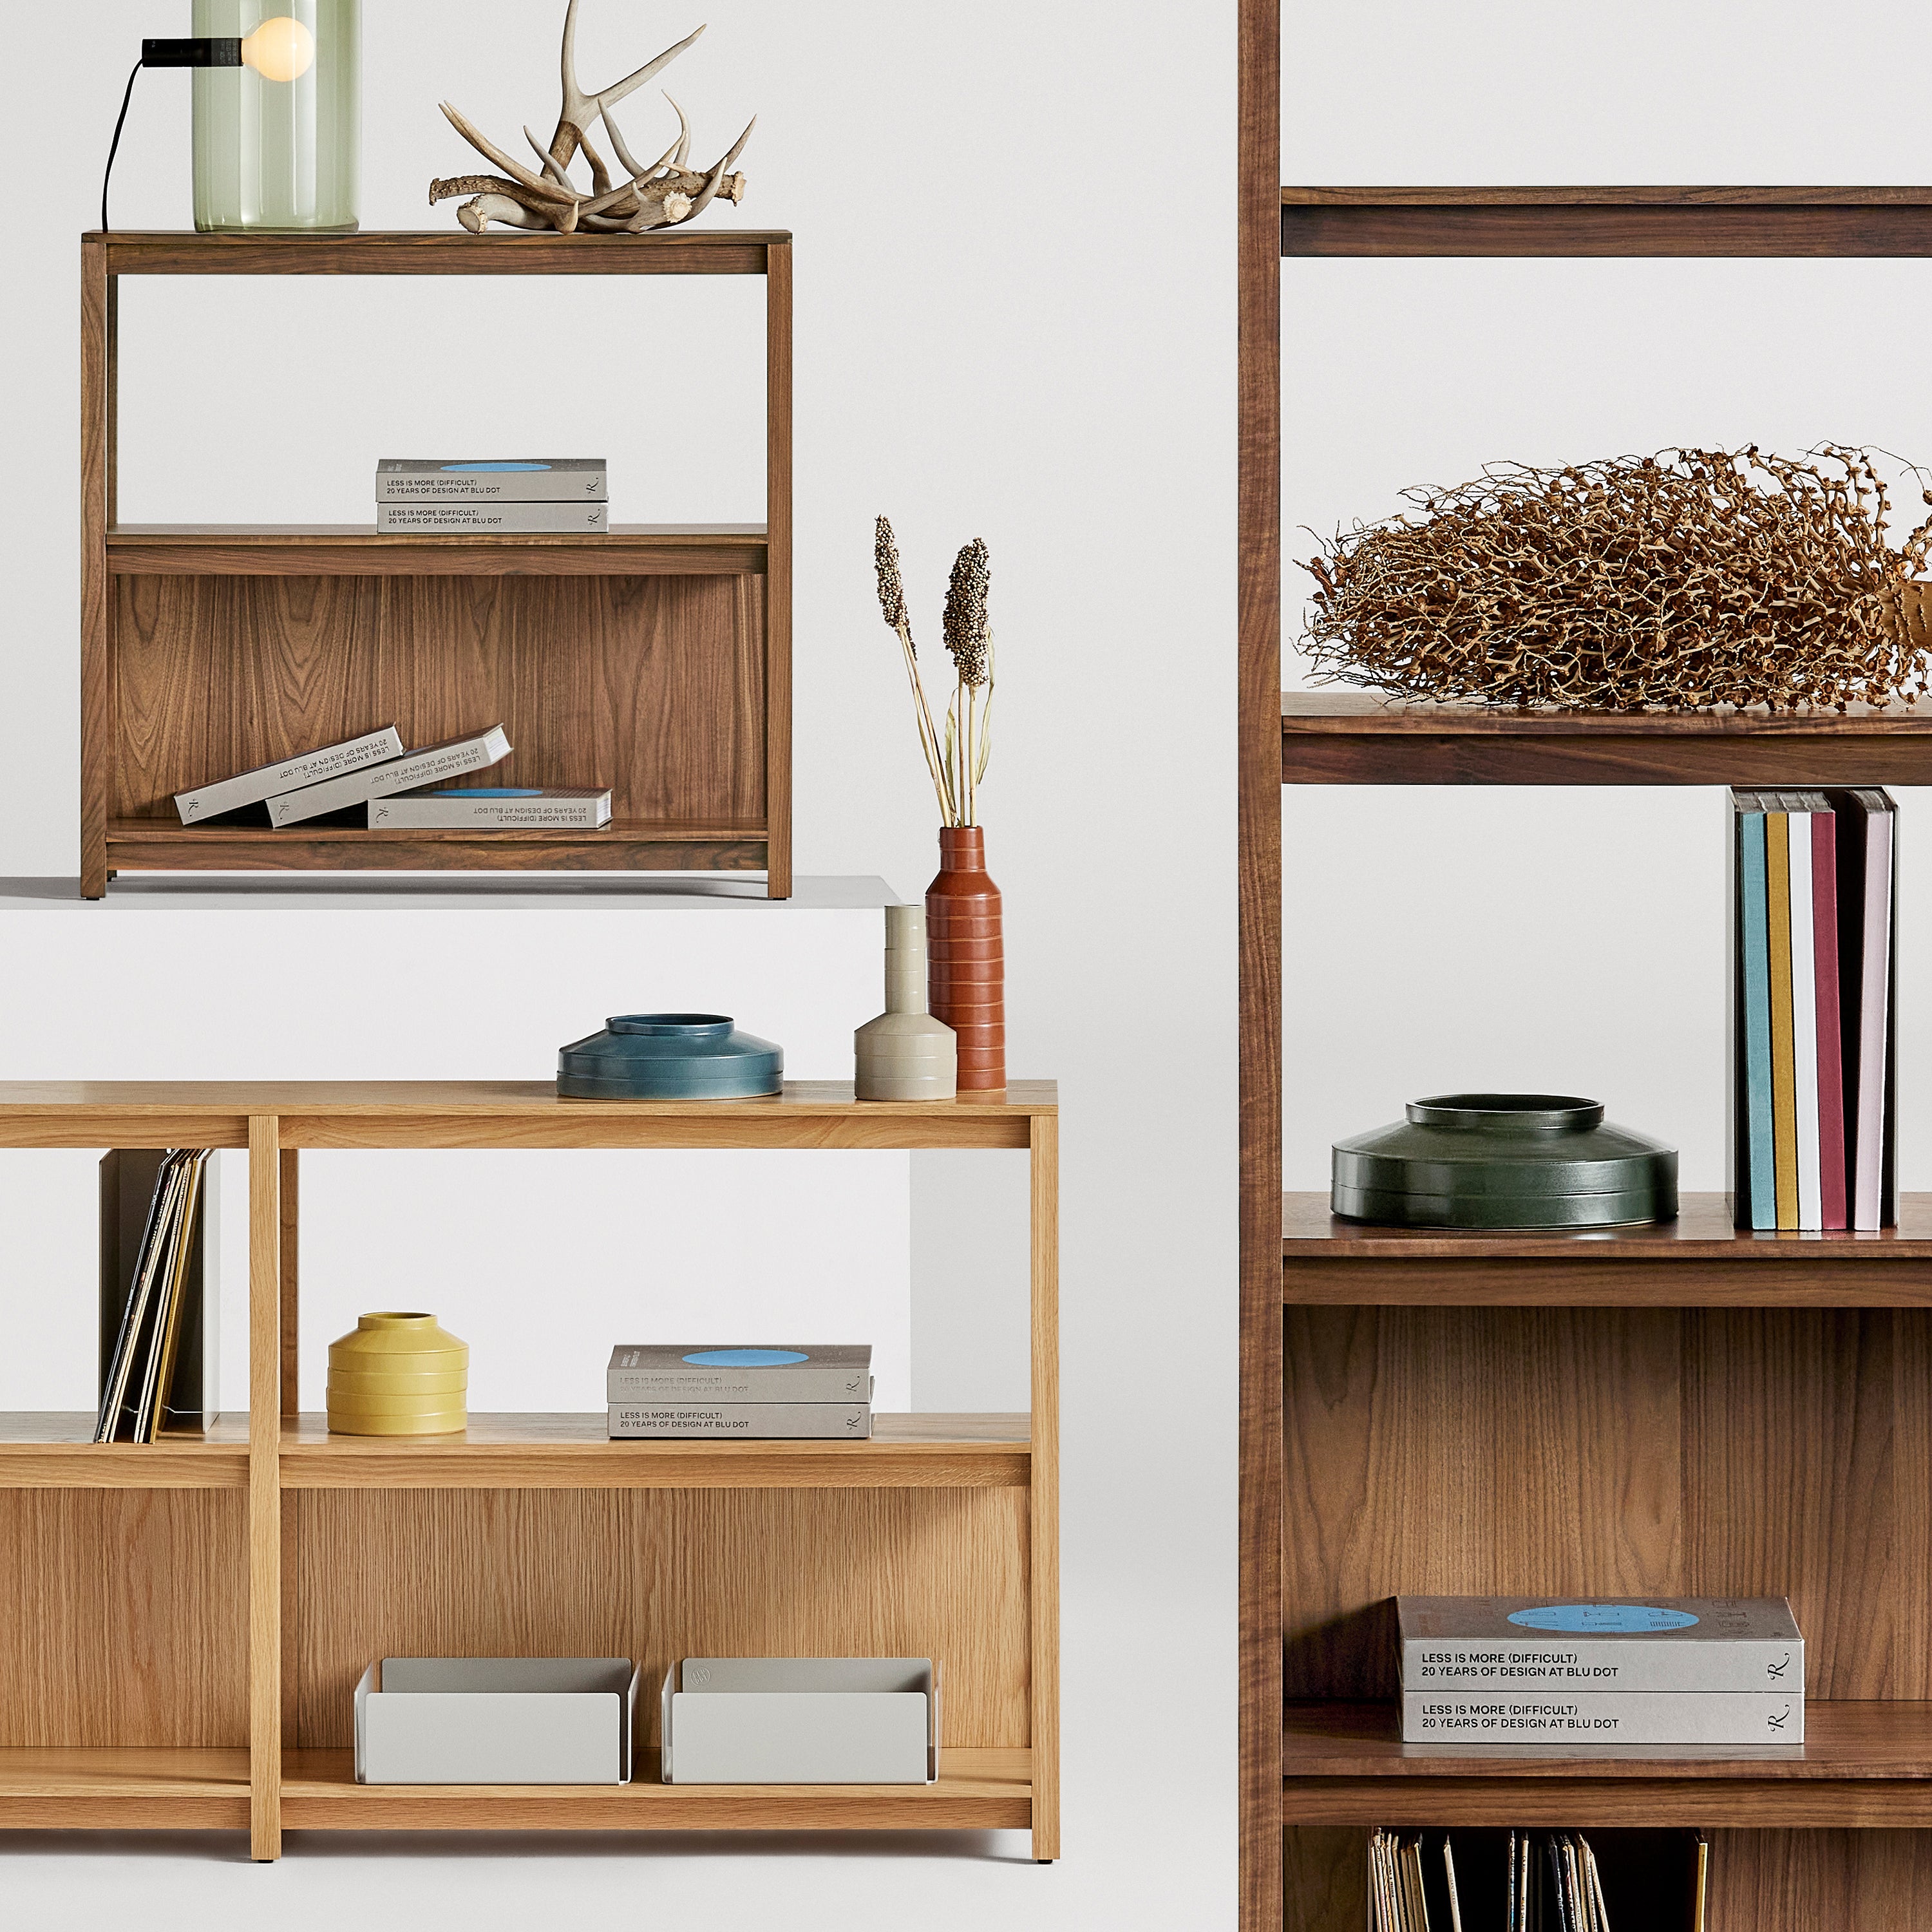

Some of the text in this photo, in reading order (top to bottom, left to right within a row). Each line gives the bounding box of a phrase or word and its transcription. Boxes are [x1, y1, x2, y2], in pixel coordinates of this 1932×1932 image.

[355, 742, 378, 754] YEARS
[372, 746, 390, 757] LESS
[318, 753, 344, 766] DESIGN
[343, 754, 363, 766] MORE
[446, 750, 469, 762] YEARS
[463, 755, 481, 765] LESS
[294, 764, 308, 773] BLU
[303, 761, 342, 779] (DIFFICULT)
[409, 761, 435, 773] DESIGN
[433, 762, 455, 773] MORE
[279, 769, 293, 779] DOT
[370, 775, 384, 784] DOT
[385, 771, 399, 779] BLU
[394, 768, 433, 785] (DIFFICULT)
[1423, 1653, 1577, 1664] LESS IS MORE (DIFFICULT)
[1422, 1667, 1618, 1677] 20 YEARS OF DESIGN AT BLU DOT
[1423, 1705, 1578, 1716] LESS IS MORE (DIFFICULT)
[1422, 1718, 1619, 1728] 20 YEARS OF DESIGN AT BLU DOT
